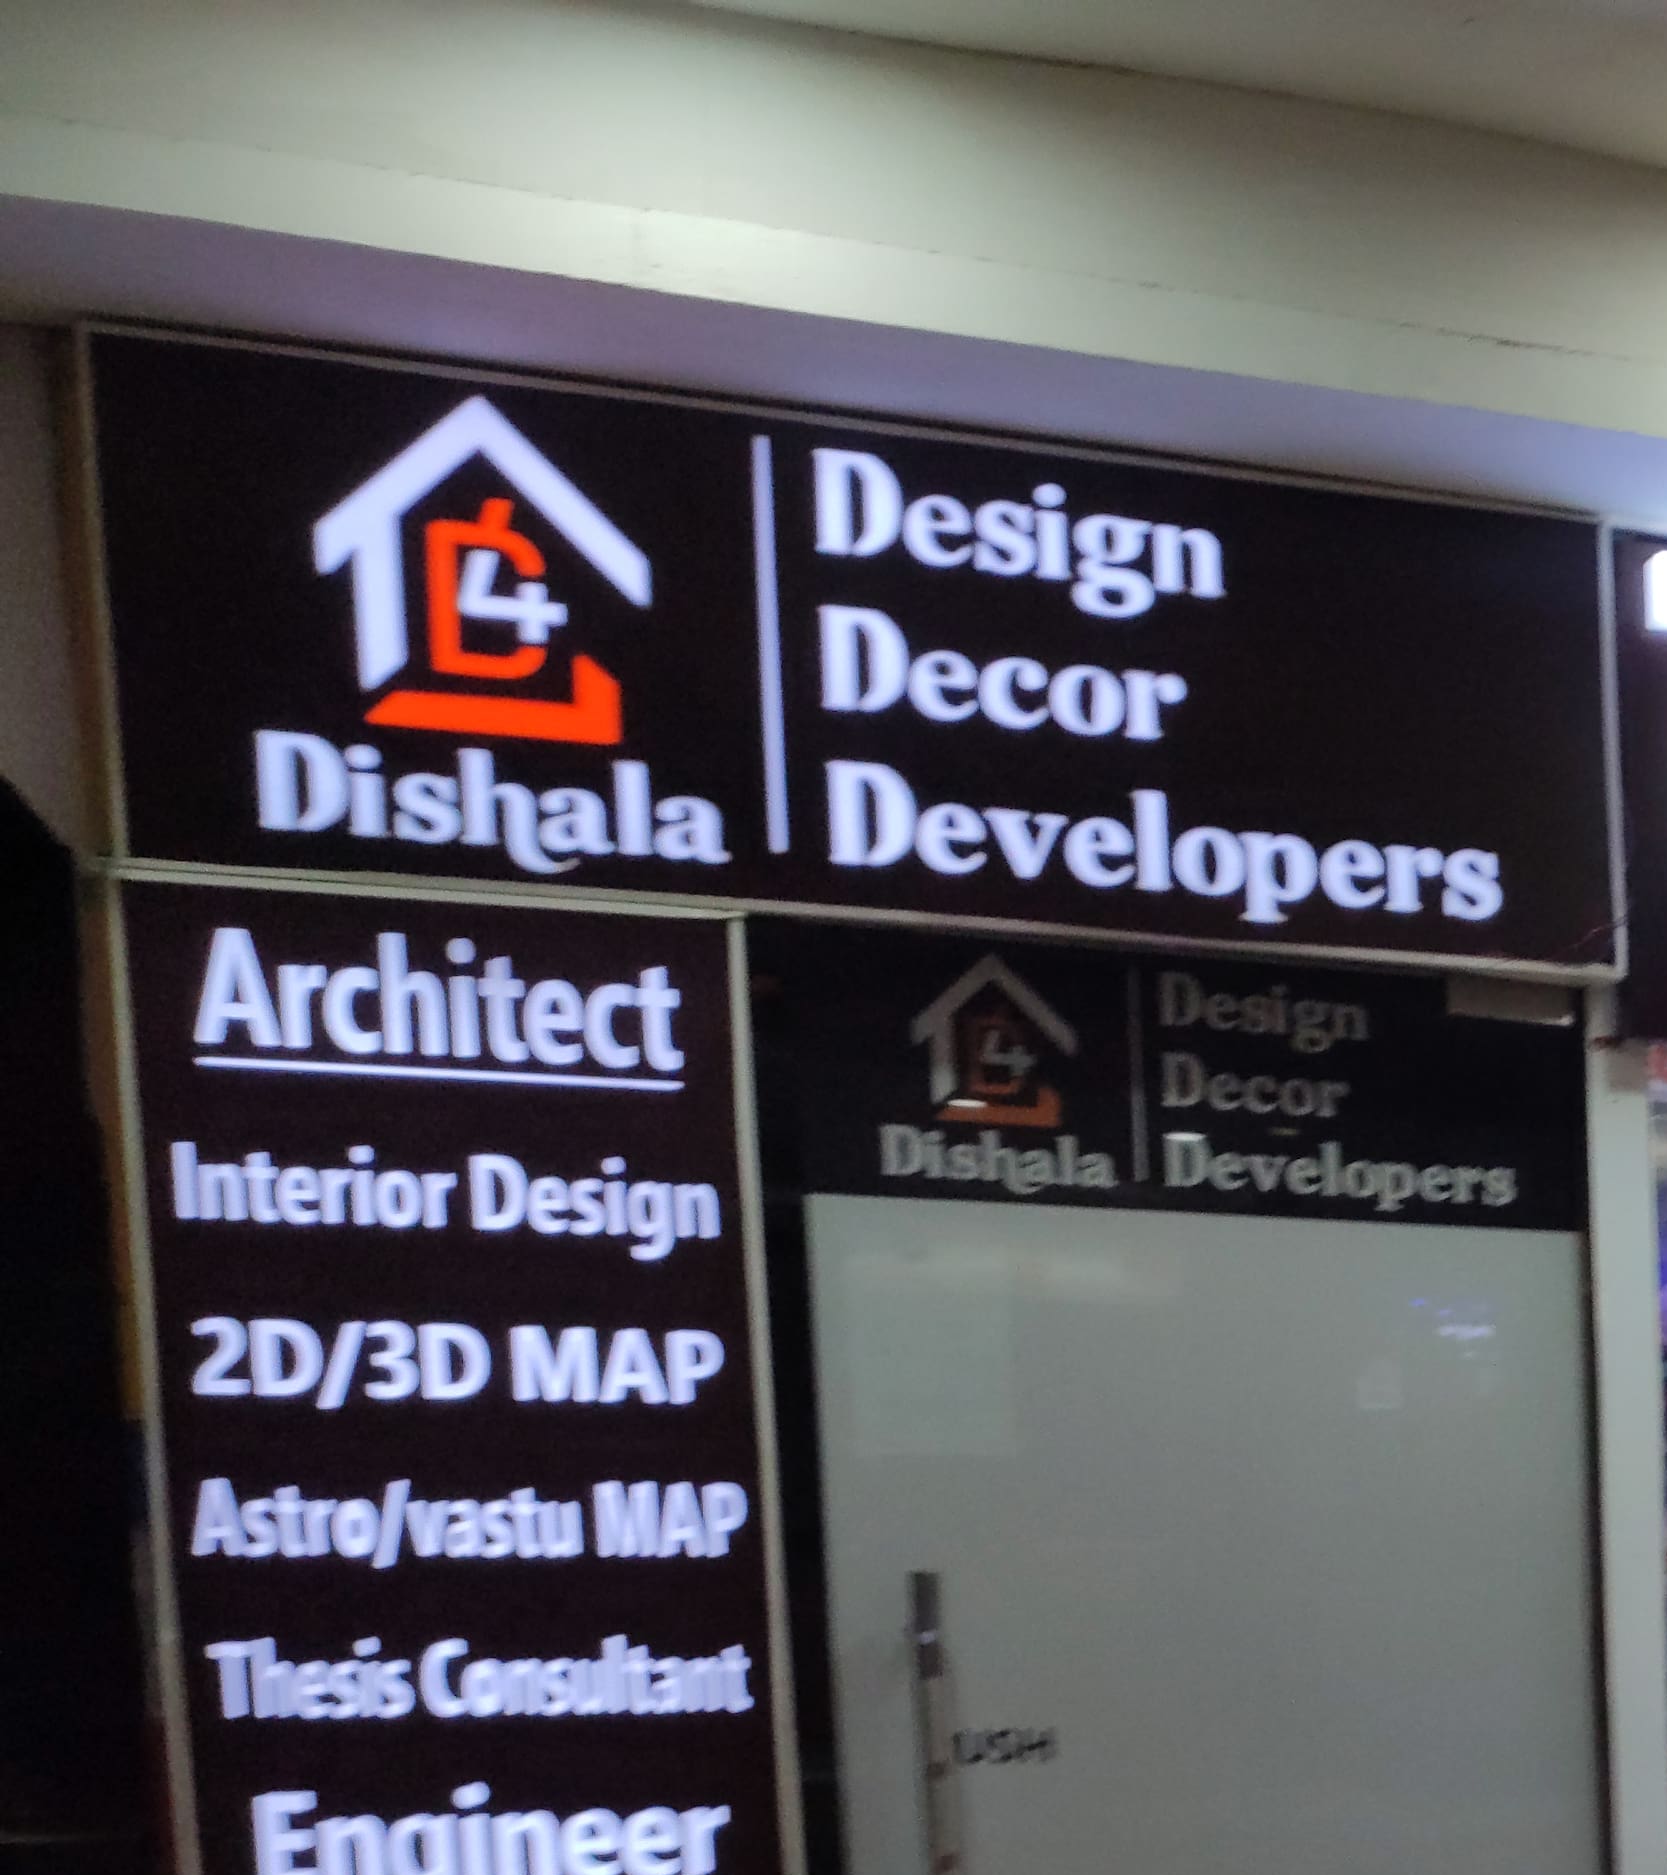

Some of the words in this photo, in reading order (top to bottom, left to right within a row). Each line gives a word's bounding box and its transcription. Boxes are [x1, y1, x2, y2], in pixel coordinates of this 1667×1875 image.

[812, 448, 1226, 619] Design
[816, 605, 1187, 741] Decor
[254, 729, 730, 874] Dishala
[825, 760, 1504, 925] Developers
[193, 928, 685, 1072] Architect
[1157, 971, 1370, 1054] Design
[1161, 1051, 1350, 1118] Decor
[170, 1141, 456, 1229] Interior
[469, 1154, 722, 1262] Design
[878, 1123, 1118, 1195] Dishala
[1163, 1132, 1518, 1211] Developers
[191, 1317, 491, 1410] 2D/3D
[508, 1325, 724, 1404] MAP
[191, 1477, 583, 1569] Astro/vastu
[592, 1480, 748, 1558] MAP
[204, 1636, 415, 1719] Thesis
[420, 1634, 754, 1718] Consultant
